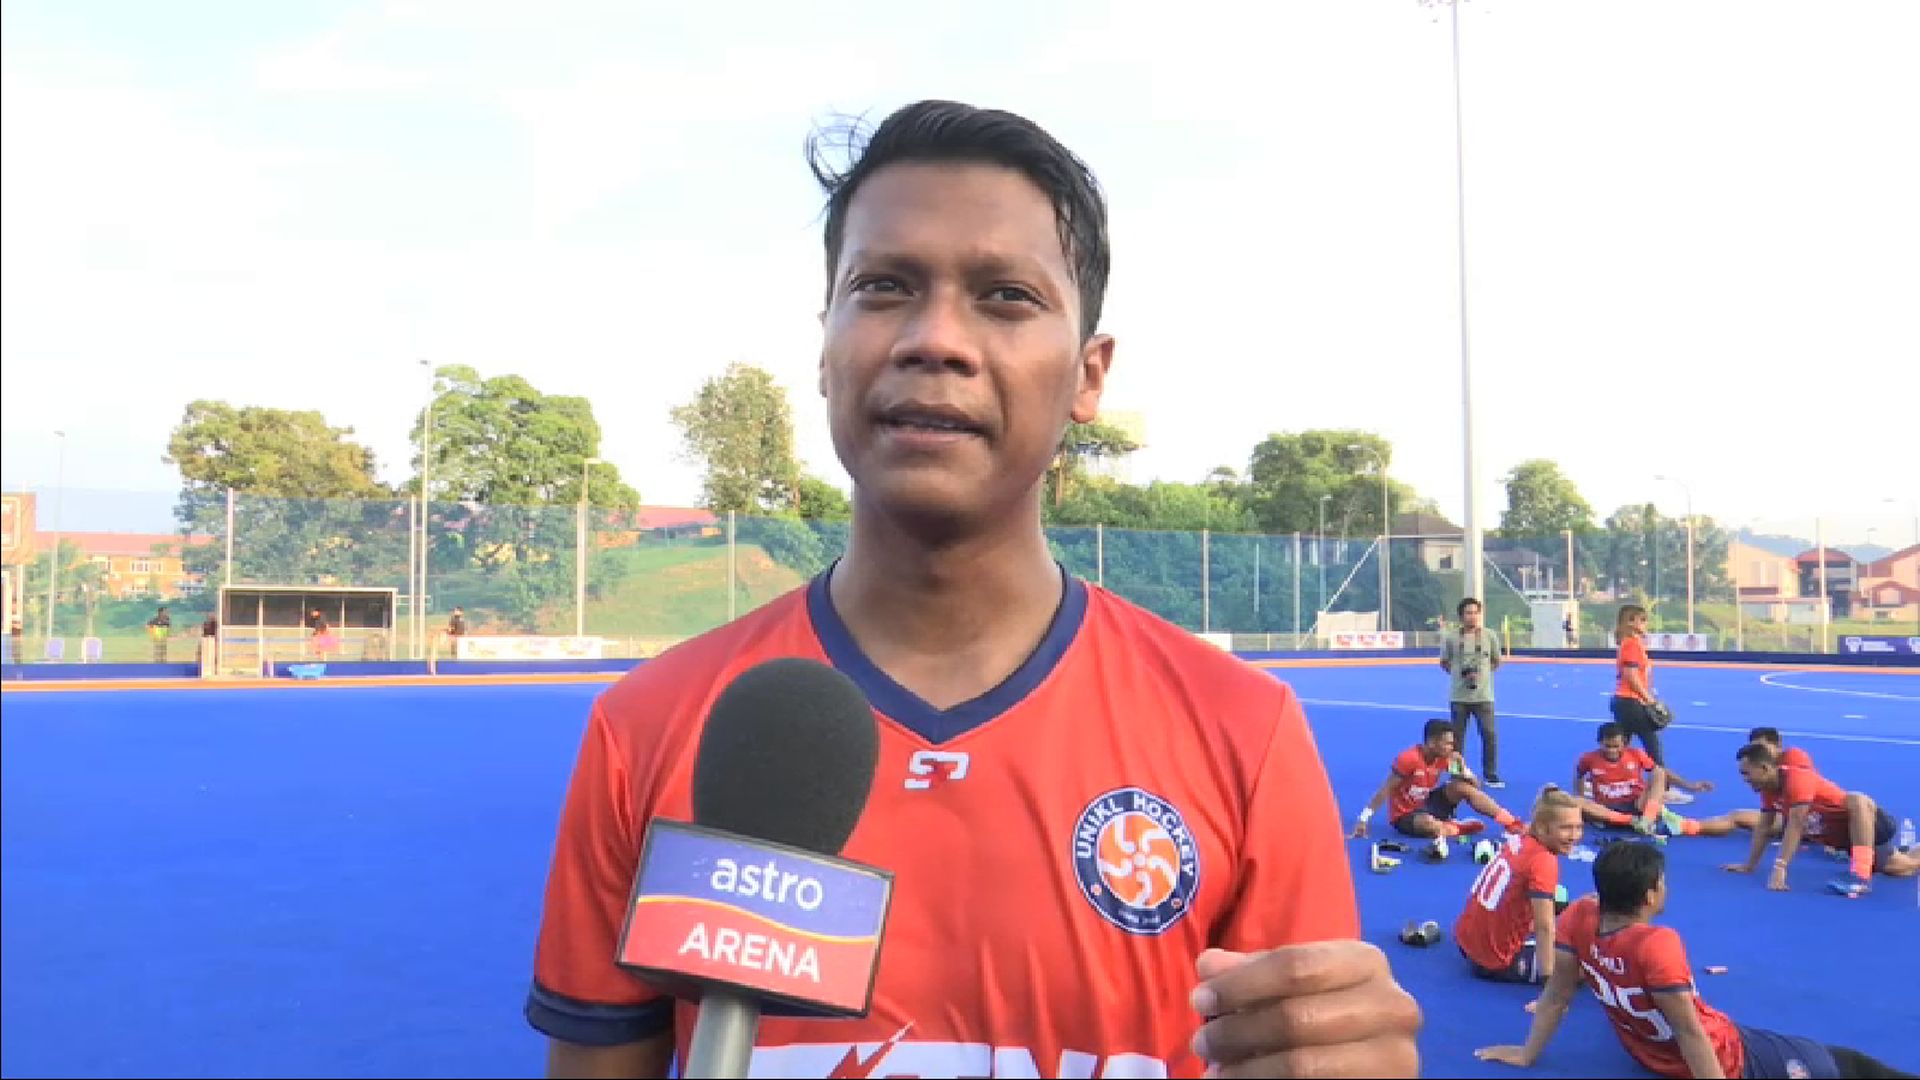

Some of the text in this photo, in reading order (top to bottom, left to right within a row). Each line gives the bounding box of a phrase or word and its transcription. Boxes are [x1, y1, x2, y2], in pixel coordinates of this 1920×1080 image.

[1076, 793, 1194, 877] UNIKL HOCKEY
[710, 858, 823, 910] astro
[678, 922, 821, 983] ARENA
